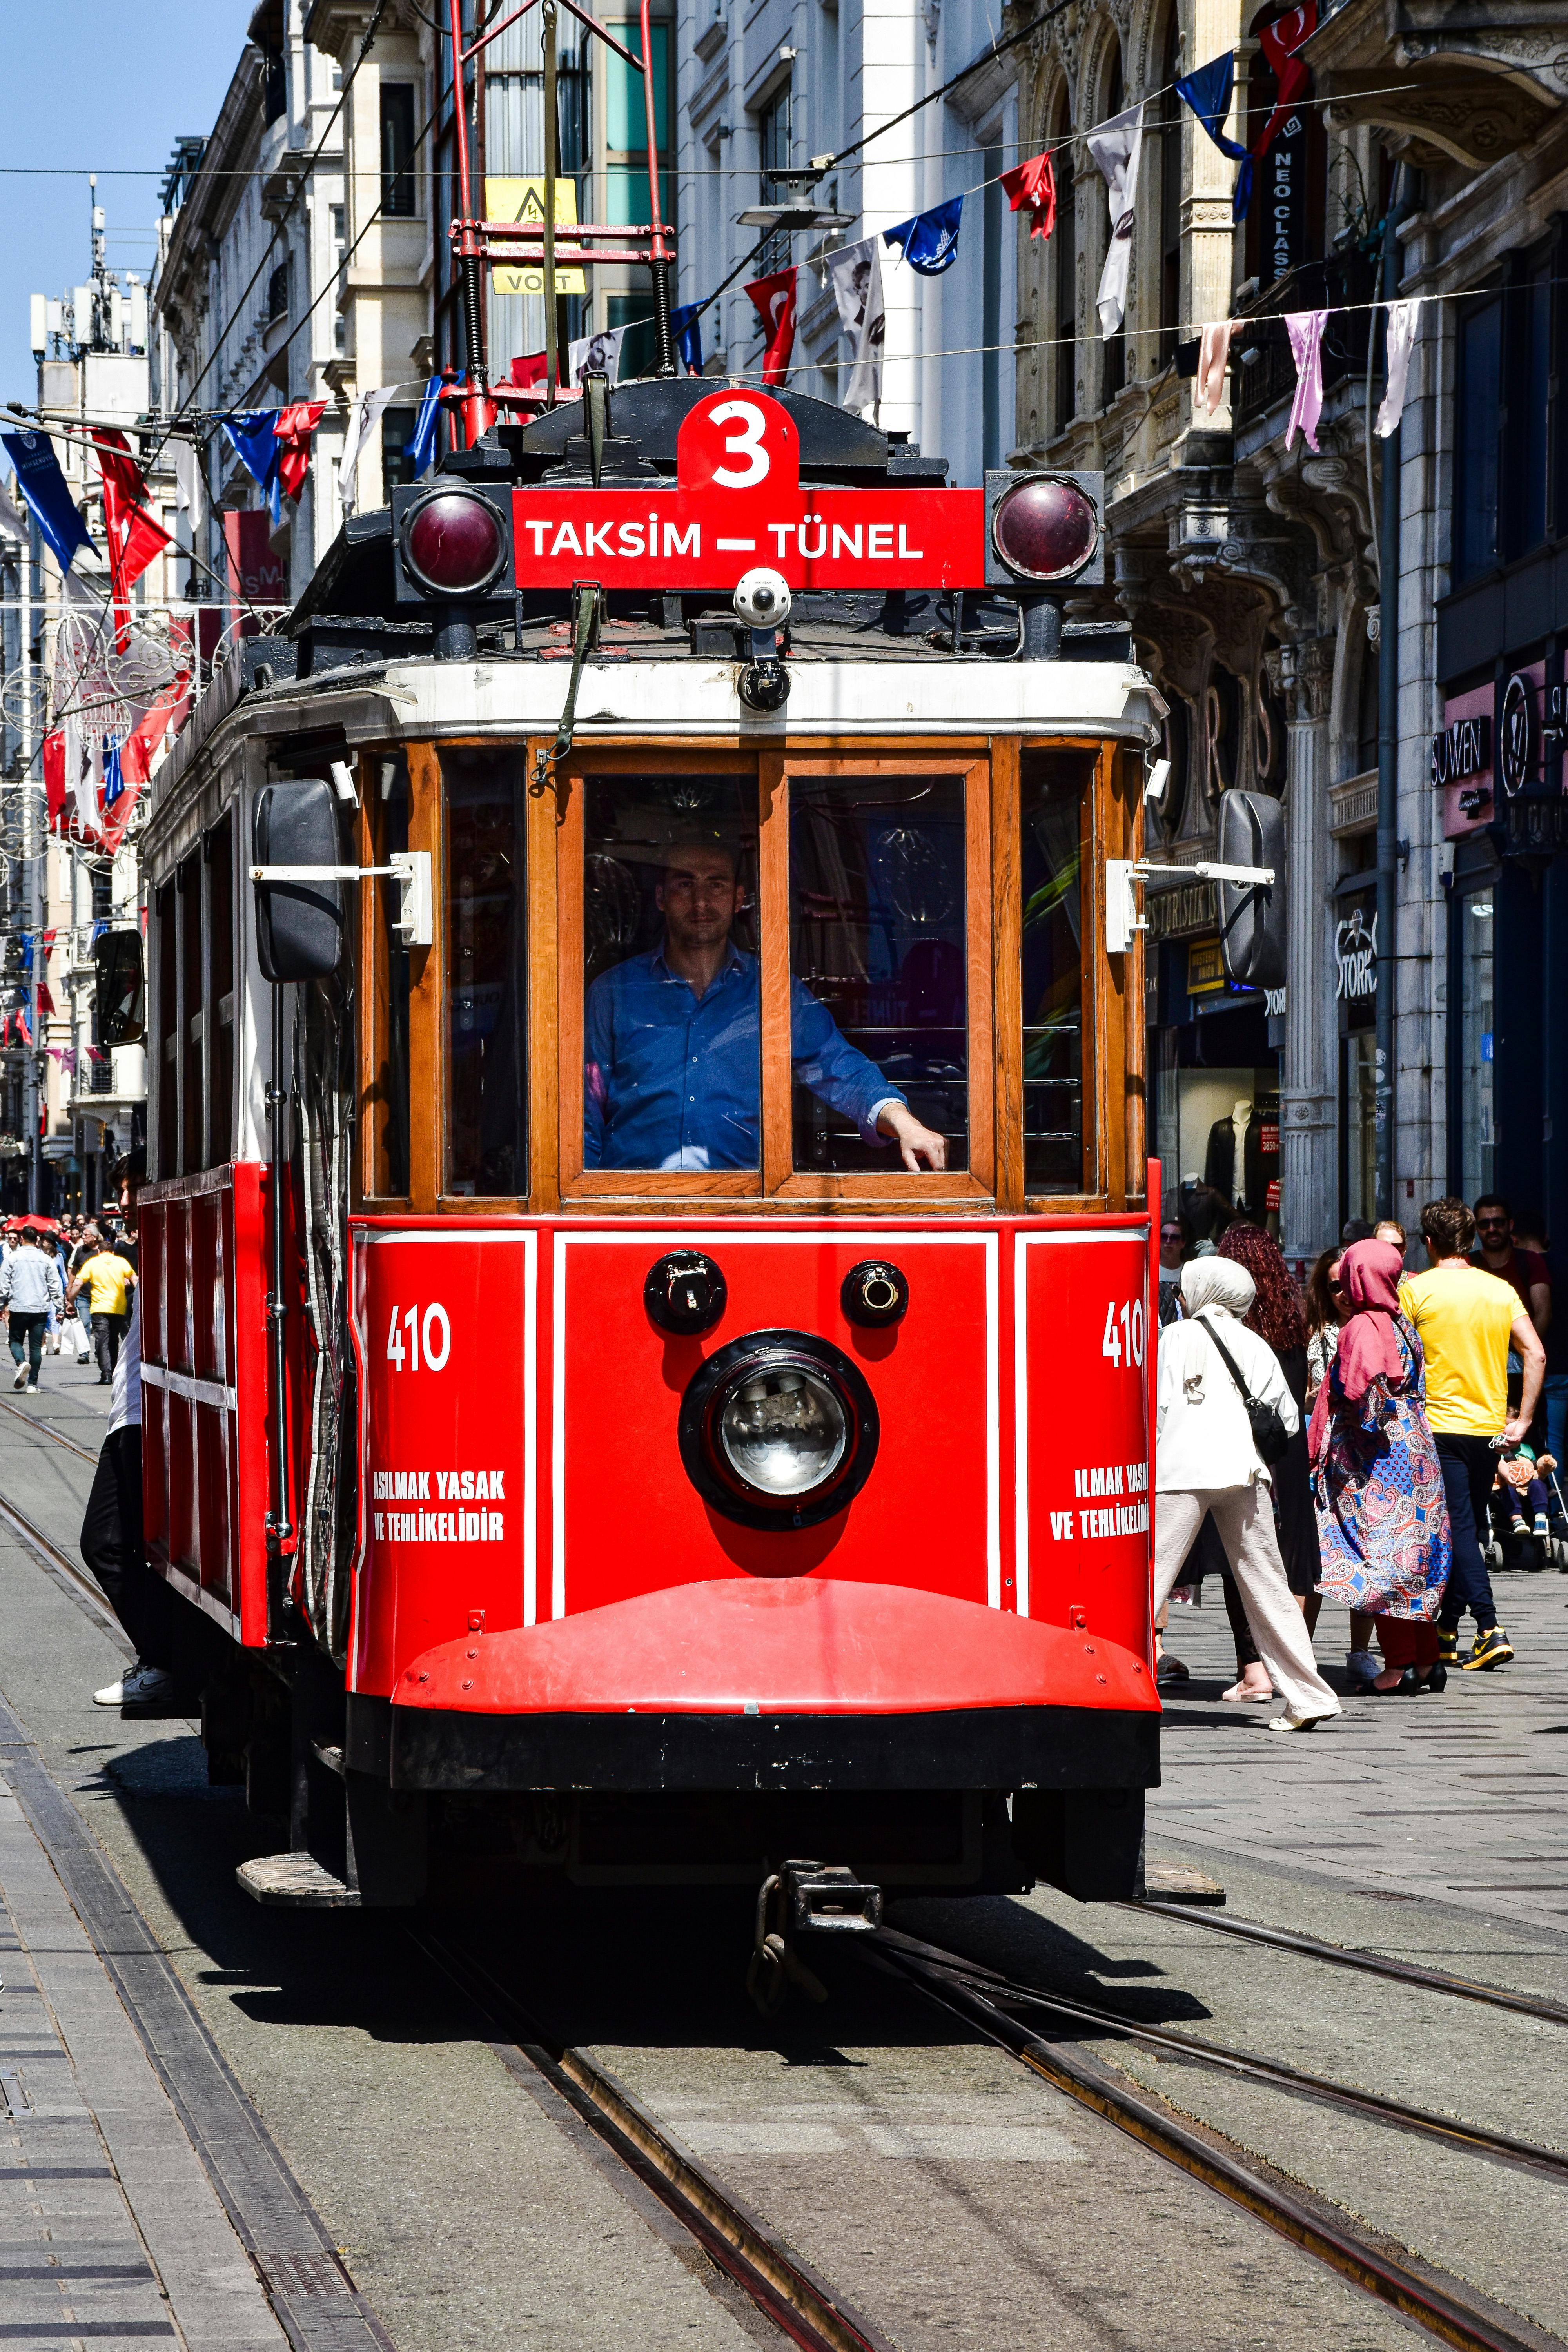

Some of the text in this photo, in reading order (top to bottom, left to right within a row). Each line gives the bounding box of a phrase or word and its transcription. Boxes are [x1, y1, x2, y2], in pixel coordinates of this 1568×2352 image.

[1274, 153, 1291, 197] NEO
[507, 275, 570, 290] VOT
[708, 401, 770, 488] 3
[525, 512, 701, 557] TAKSİM
[768, 514, 923, 559] TÜNEL
[1431, 718, 1480, 786] SUWEN
[387, 1303, 451, 1372] 410
[1102, 1299, 1143, 1368] 410
[374, 1470, 505, 1500] ASILMAK YASAK
[1074, 1466, 1124, 1498] ILMAK
[387, 1507, 504, 1541] TEHLİKELİDİR
[1050, 1511, 1074, 1540] VE
